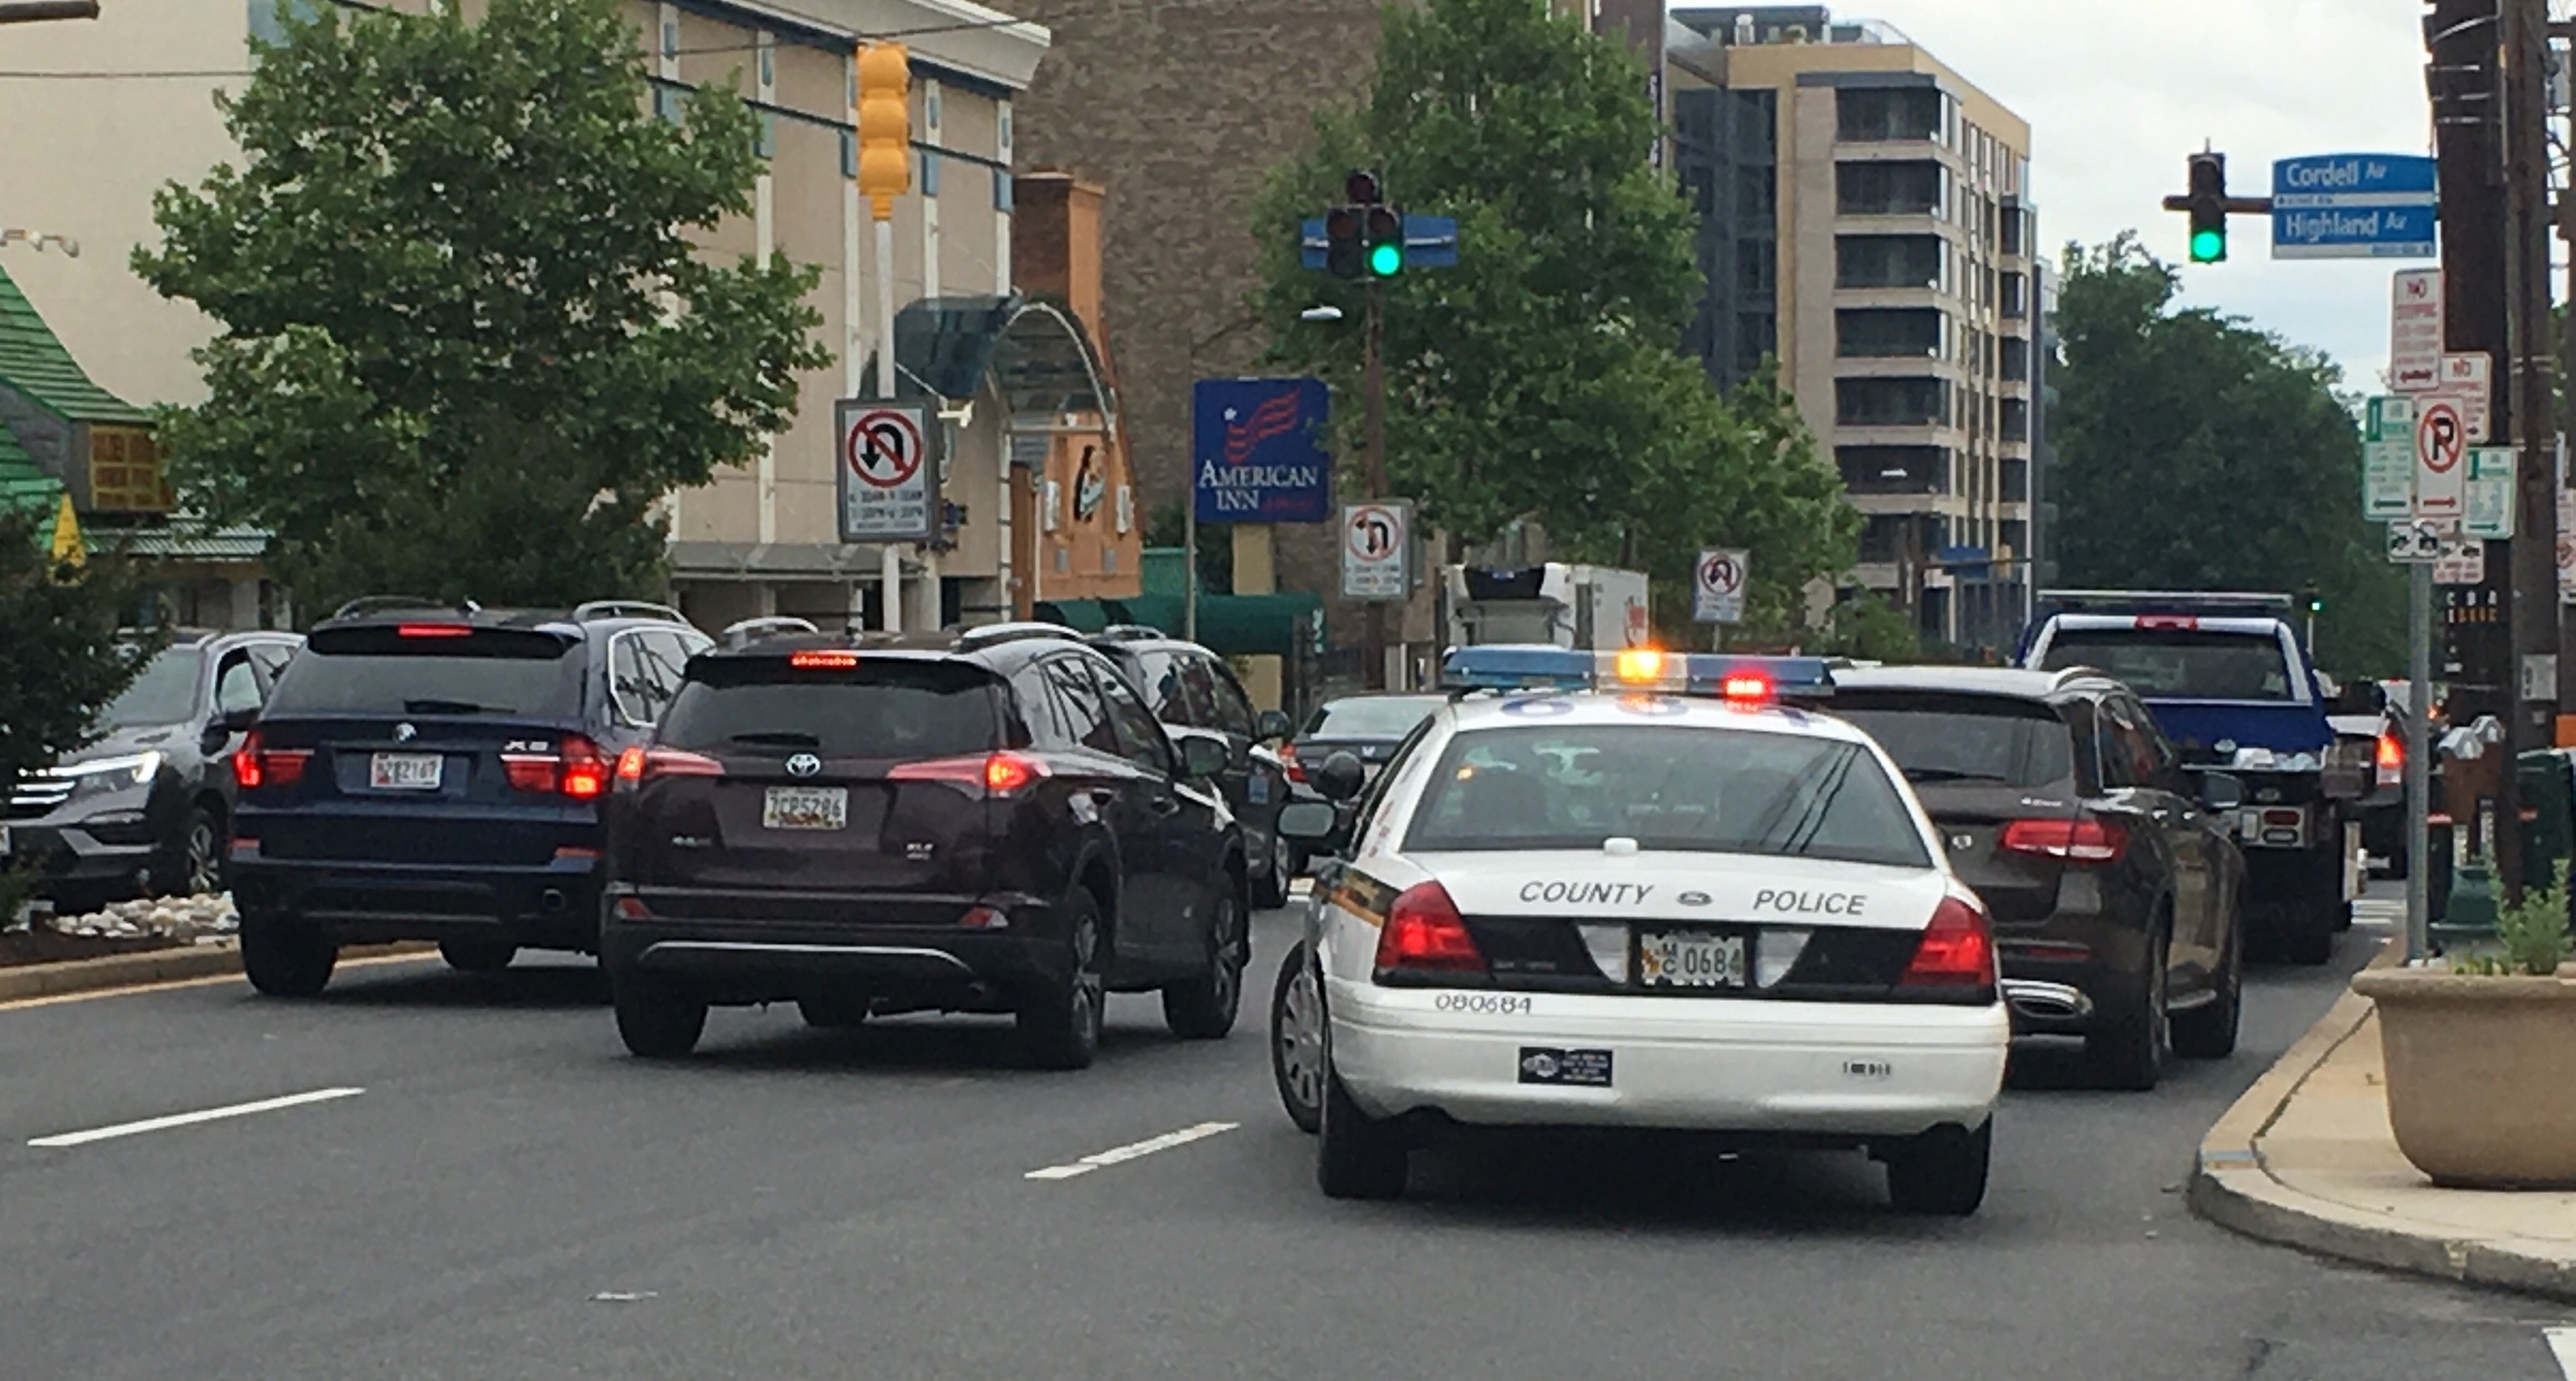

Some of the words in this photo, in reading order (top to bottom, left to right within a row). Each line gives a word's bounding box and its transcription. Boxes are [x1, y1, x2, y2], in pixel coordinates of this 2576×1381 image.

[2286, 159, 2359, 188] Cordell
[2285, 211, 2380, 243] Highland
[1199, 459, 1318, 488] AMERICAN
[1216, 490, 1259, 511] INN
[1519, 881, 1655, 905] COUNTY
[1753, 888, 1868, 916] POLICE
[1684, 948, 1742, 975] 0684
[1435, 992, 1532, 1015] 080684
